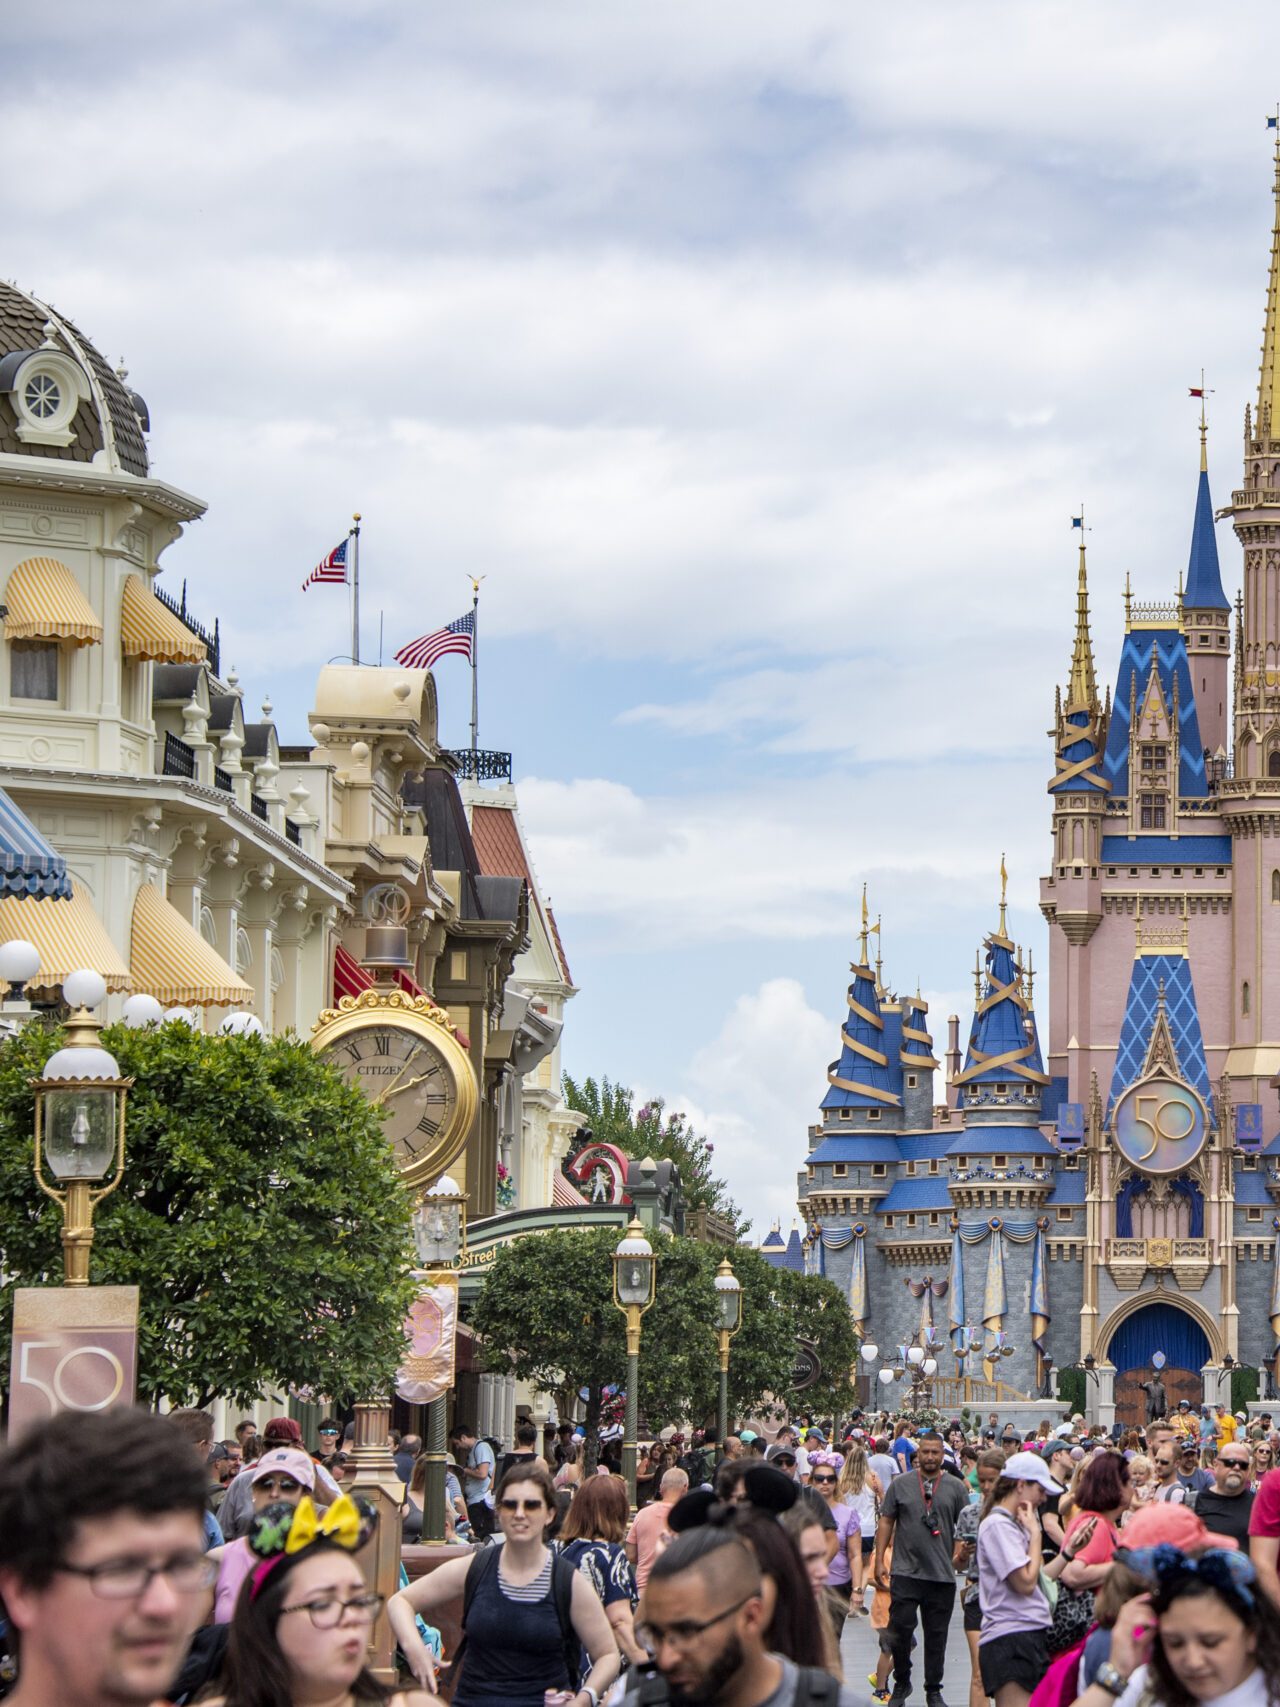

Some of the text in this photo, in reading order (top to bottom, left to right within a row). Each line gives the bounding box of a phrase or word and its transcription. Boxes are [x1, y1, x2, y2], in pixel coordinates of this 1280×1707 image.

[357, 1065, 405, 1075] CITIZEN
[1135, 1095, 1195, 1162] 50
[20, 1340, 123, 1418] 50
